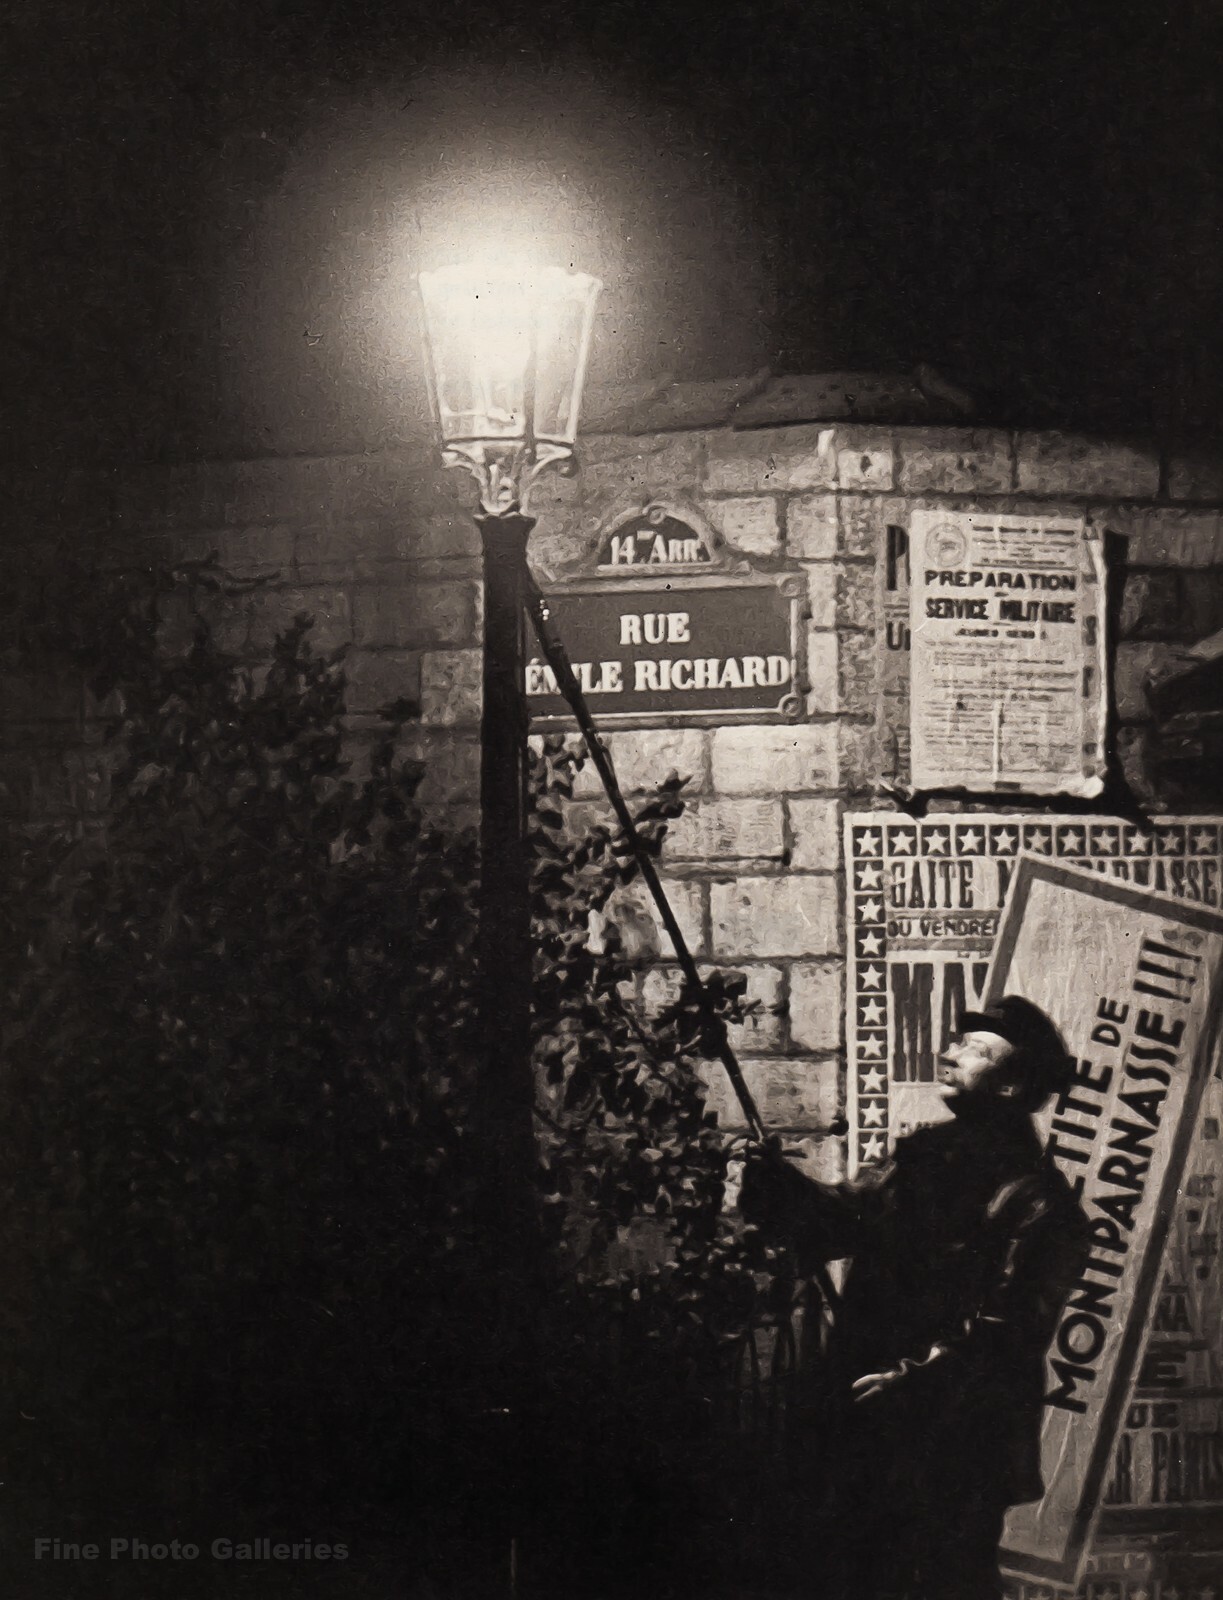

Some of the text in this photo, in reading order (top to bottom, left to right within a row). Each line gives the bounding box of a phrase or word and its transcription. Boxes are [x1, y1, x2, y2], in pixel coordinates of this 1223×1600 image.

[924, 569, 1077, 591] PREPARATION
[926, 597, 990, 620] SERVICE
[619, 612, 691, 645] RUE
[634, 655, 792, 691] RICHARD
[1090, 997, 1130, 1048] DE
[1045, 1008, 1187, 1414] MONTPARNASSE
